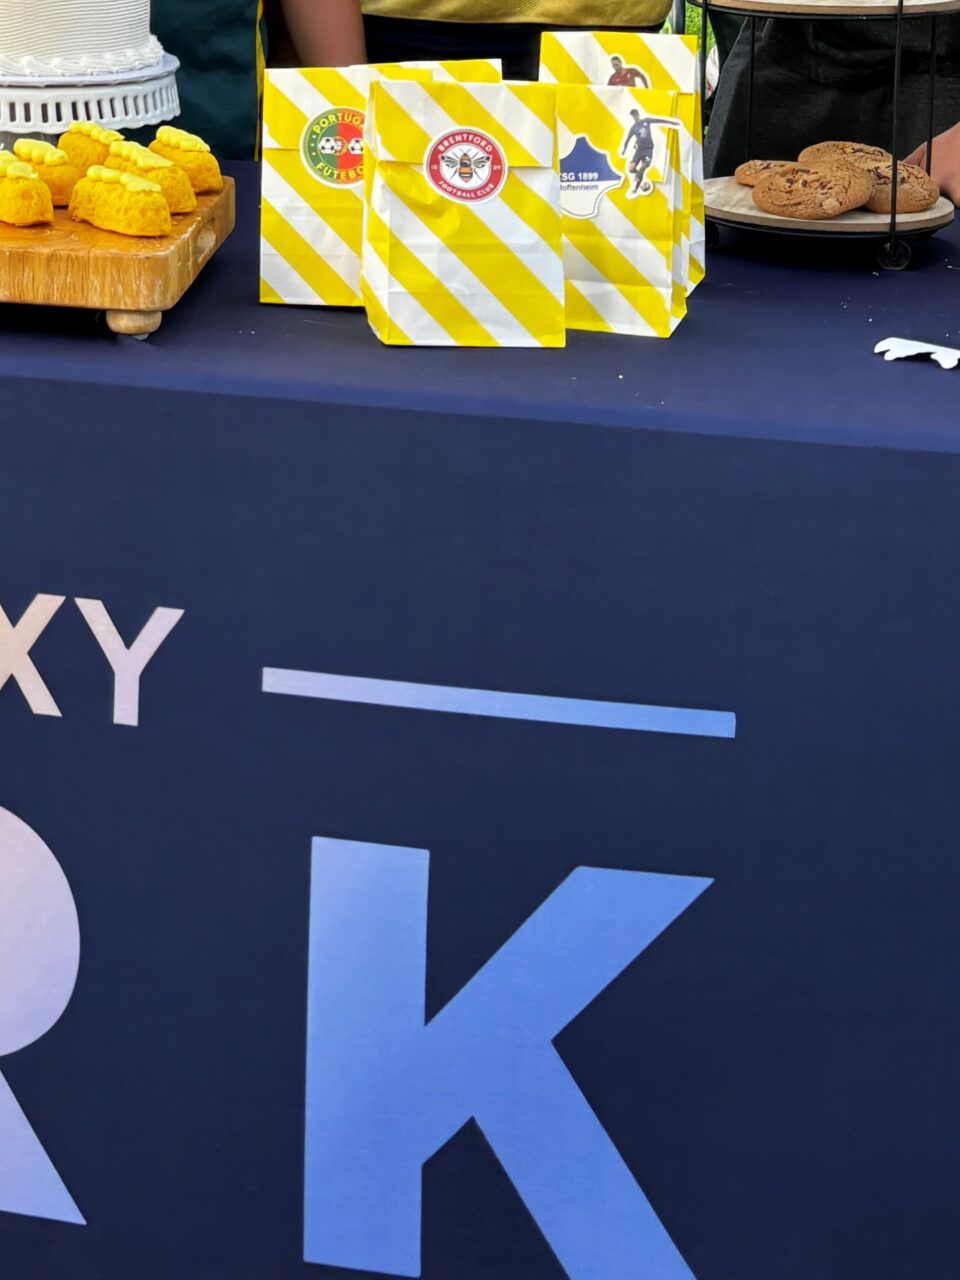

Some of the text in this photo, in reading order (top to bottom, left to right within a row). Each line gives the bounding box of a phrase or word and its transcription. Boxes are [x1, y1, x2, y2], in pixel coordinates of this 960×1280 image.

[312, 112, 364, 134] PORTUG
[437, 133, 493, 152] BRENTFORD
[315, 161, 364, 180] FUTEBO
[560, 172, 599, 181] SG 1899
[438, 180, 495, 198] FOOTBALL CLUB
